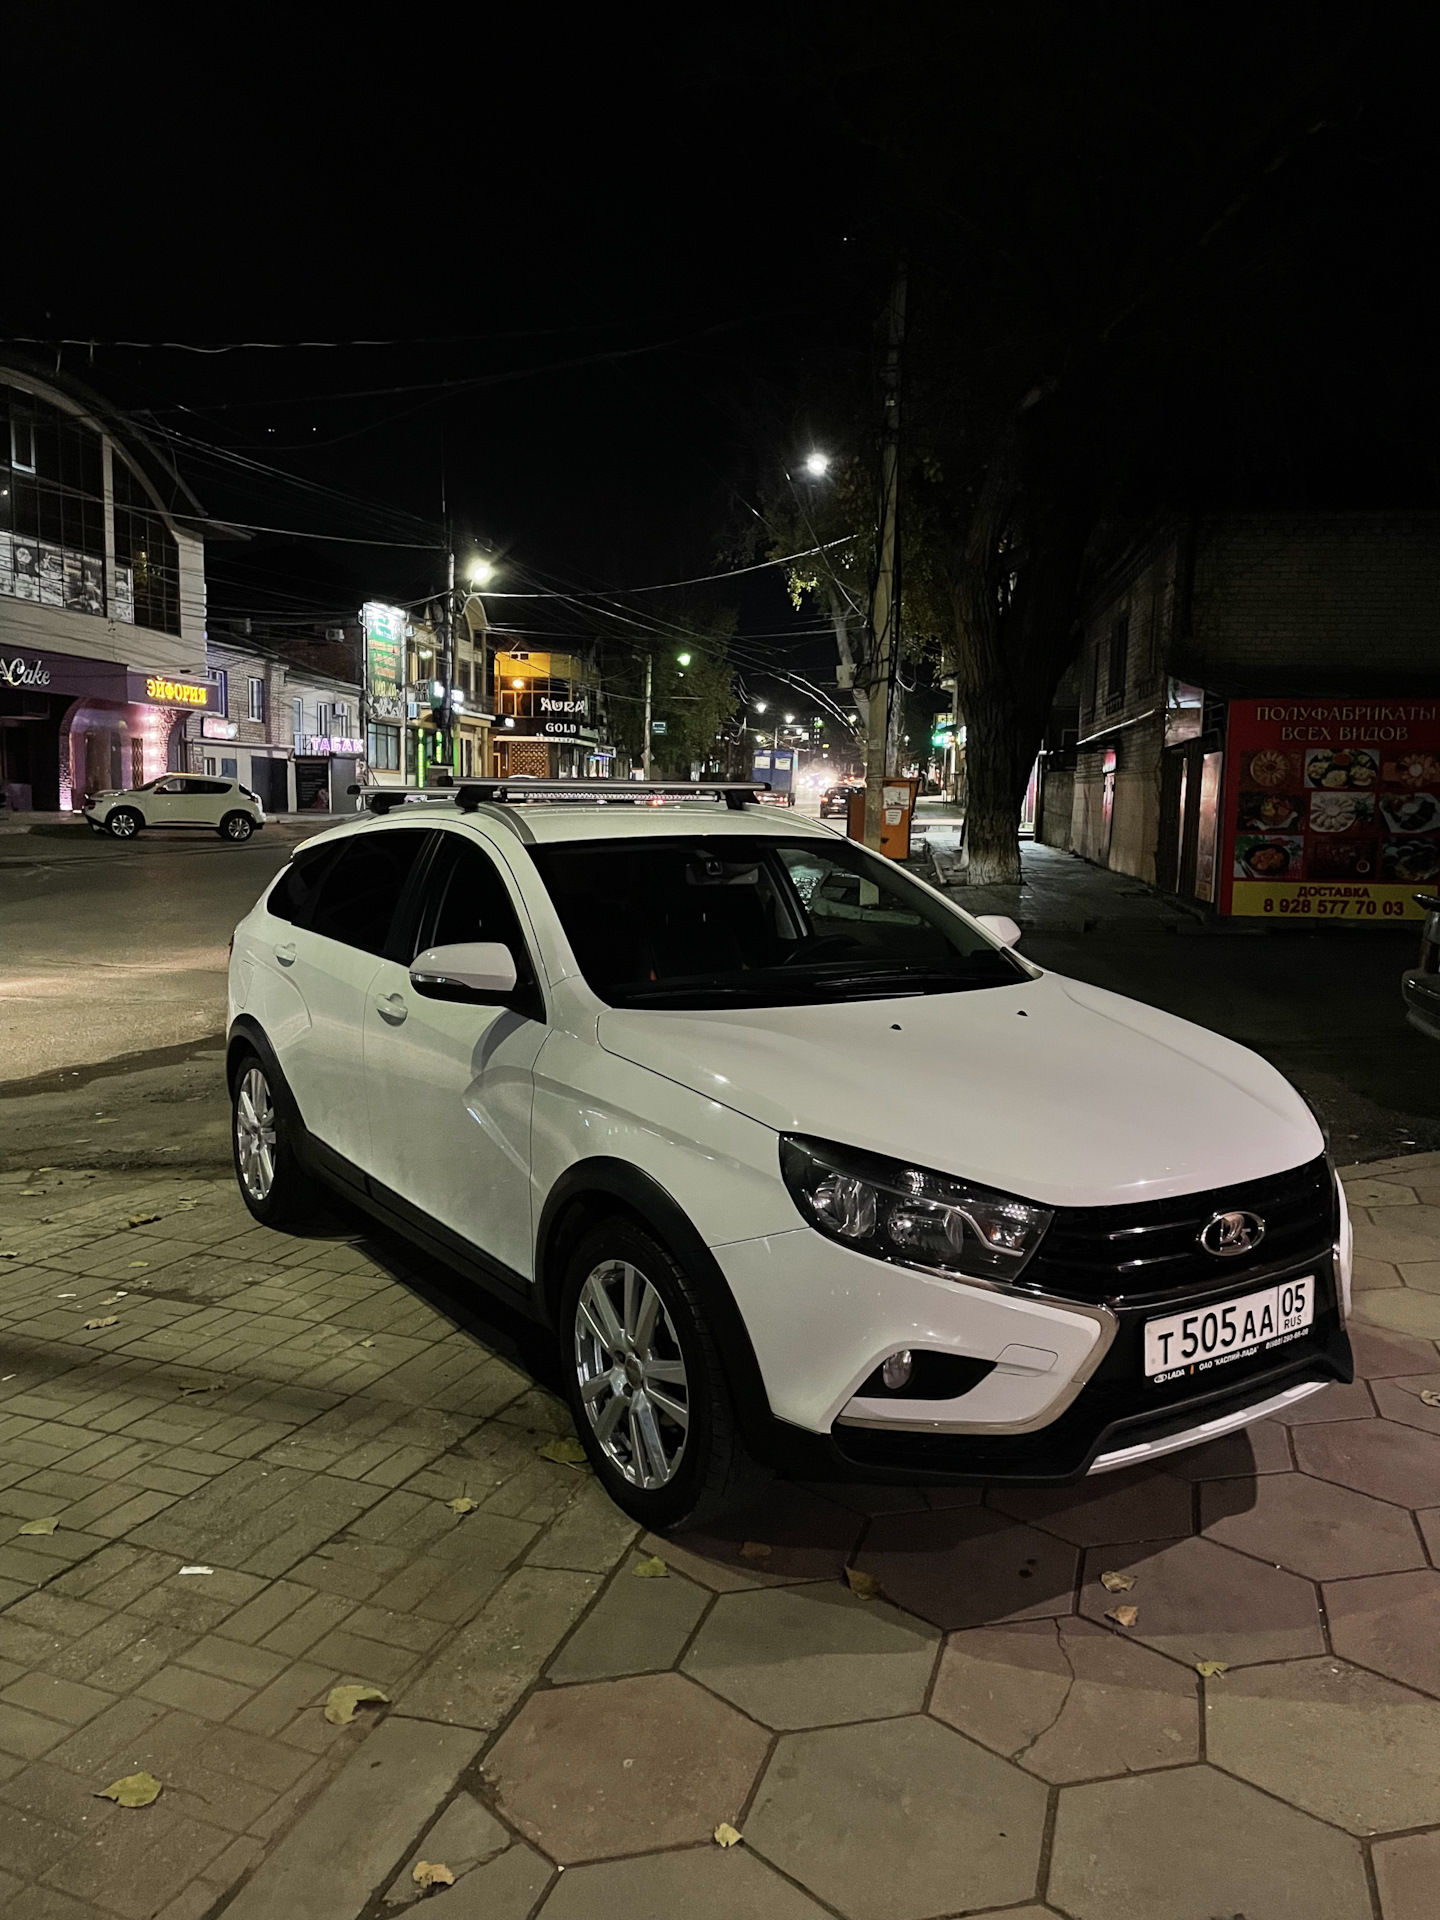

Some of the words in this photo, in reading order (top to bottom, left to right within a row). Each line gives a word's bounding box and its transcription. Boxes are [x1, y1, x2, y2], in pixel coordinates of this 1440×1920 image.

[146, 675, 207, 704] ЭЙФОРИЯ
[1256, 706, 1436, 721] ПОЛУФАБРИКАТЫ
[545, 722, 576, 733] GOLD
[1281, 726, 1331, 741] ВСЕХ
[1339, 726, 1408, 742] ВИДОВ
[311, 737, 364, 753] ТАБАК
[1297, 887, 1370, 898] ДОСТАВКА
[1264, 898, 1273, 912] 8
[1279, 899, 1311, 913] 928
[1317, 900, 1350, 914] 577
[1355, 900, 1376, 915] 70
[1382, 901, 1404, 915] 03
[1282, 1283, 1306, 1316] 05
[1284, 1315, 1302, 1330] RUS
[1168, 1369, 1185, 1380] LADA
[1199, 1361, 1213, 1371] ОАО
